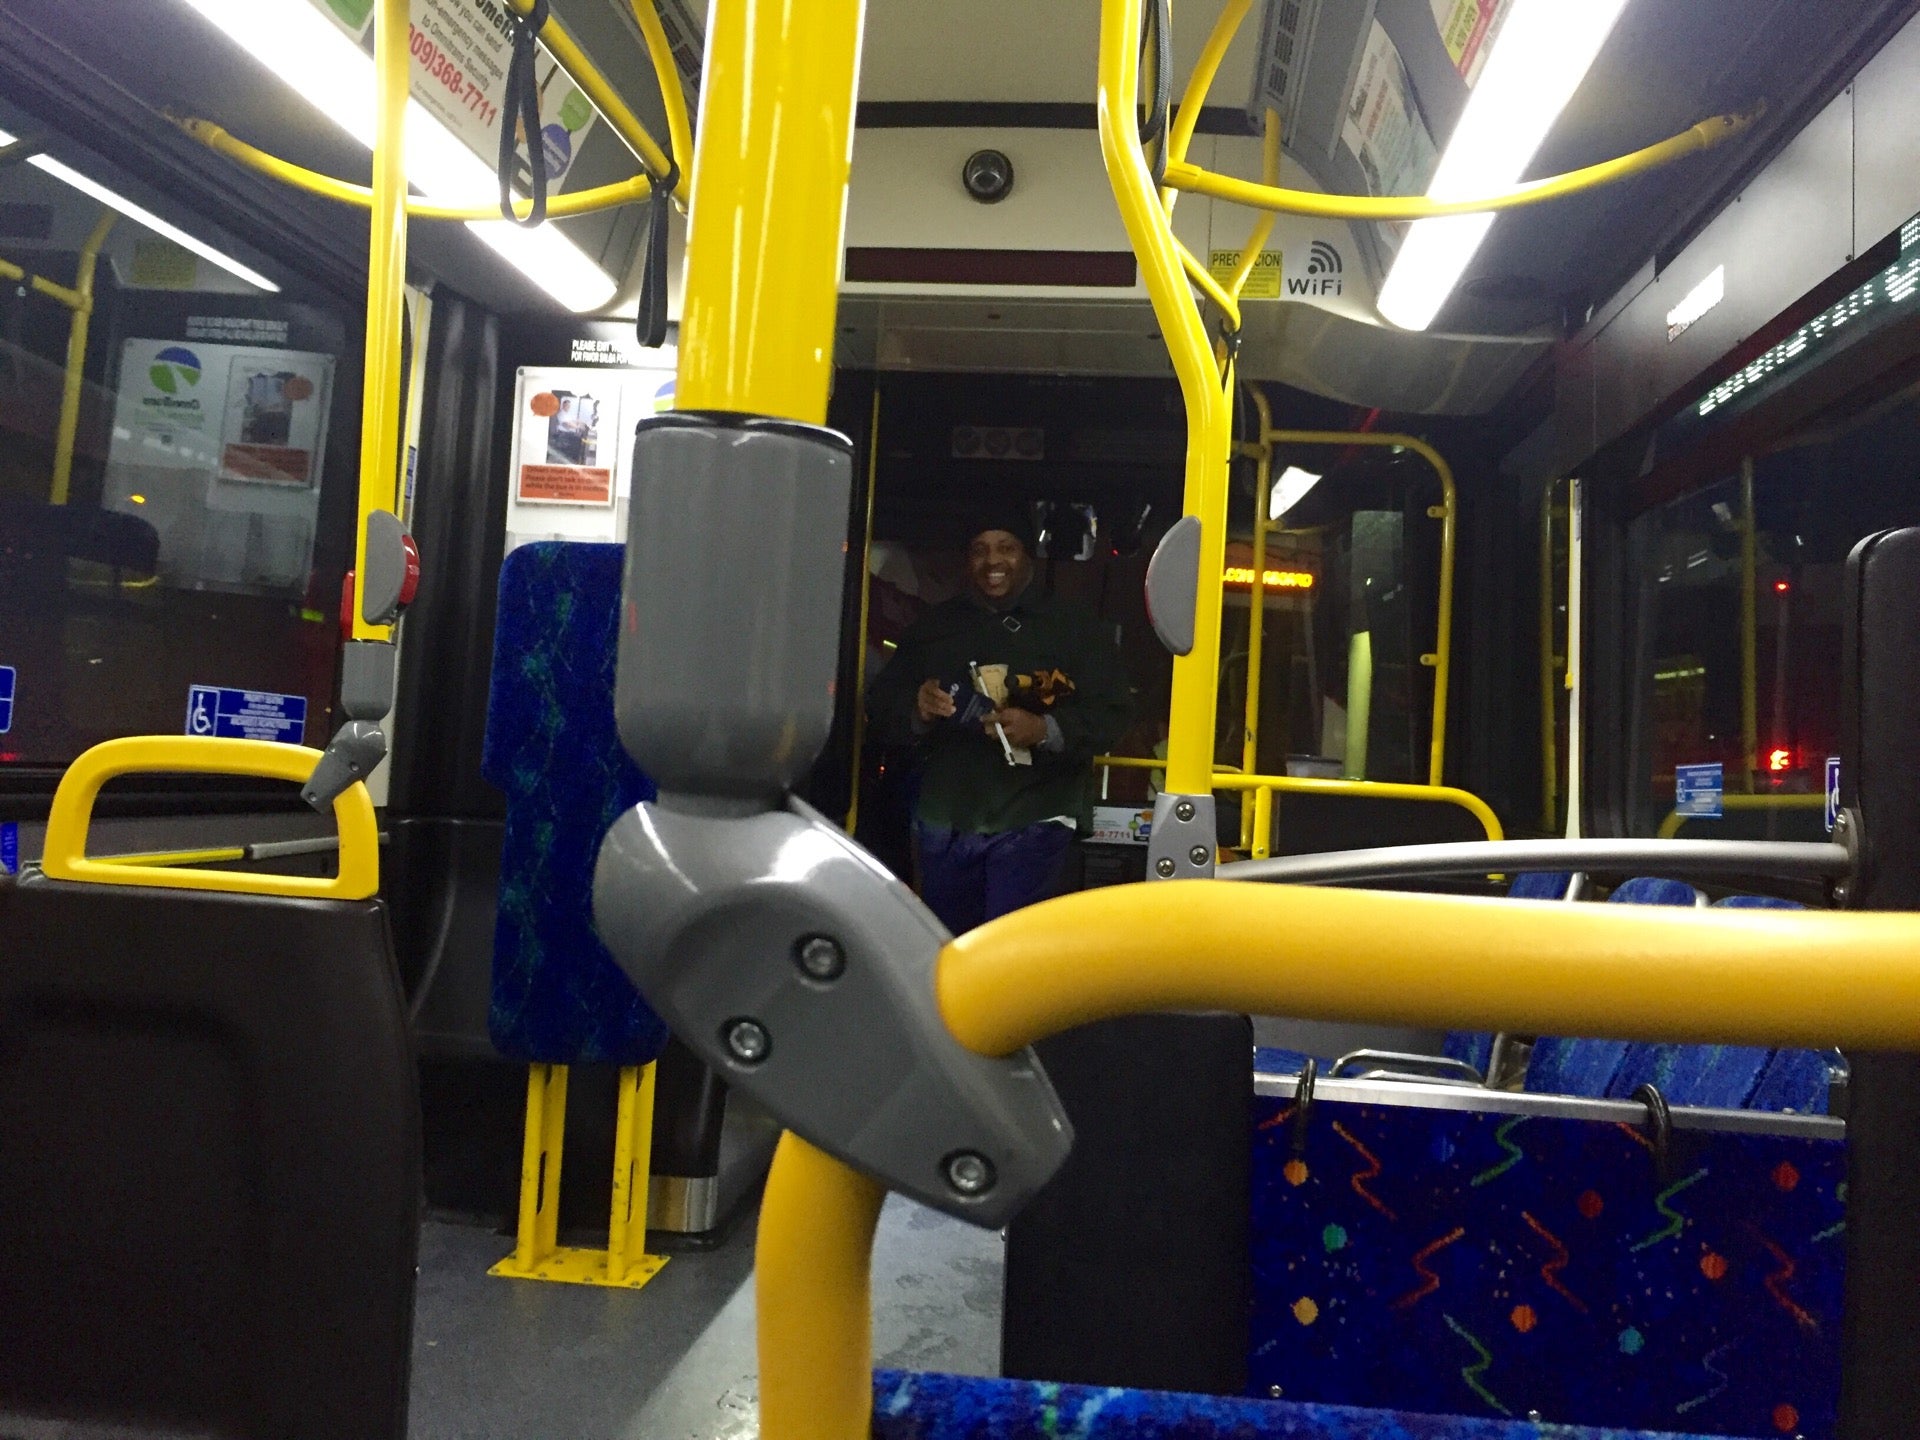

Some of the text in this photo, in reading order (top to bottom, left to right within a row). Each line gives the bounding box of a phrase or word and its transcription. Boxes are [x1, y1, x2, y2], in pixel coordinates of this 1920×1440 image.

[421, 14, 431, 28] to
[1212, 252, 1281, 267] PRECCION
[1288, 277, 1342, 296] WiFi
[572, 339, 597, 352] PLEASE
